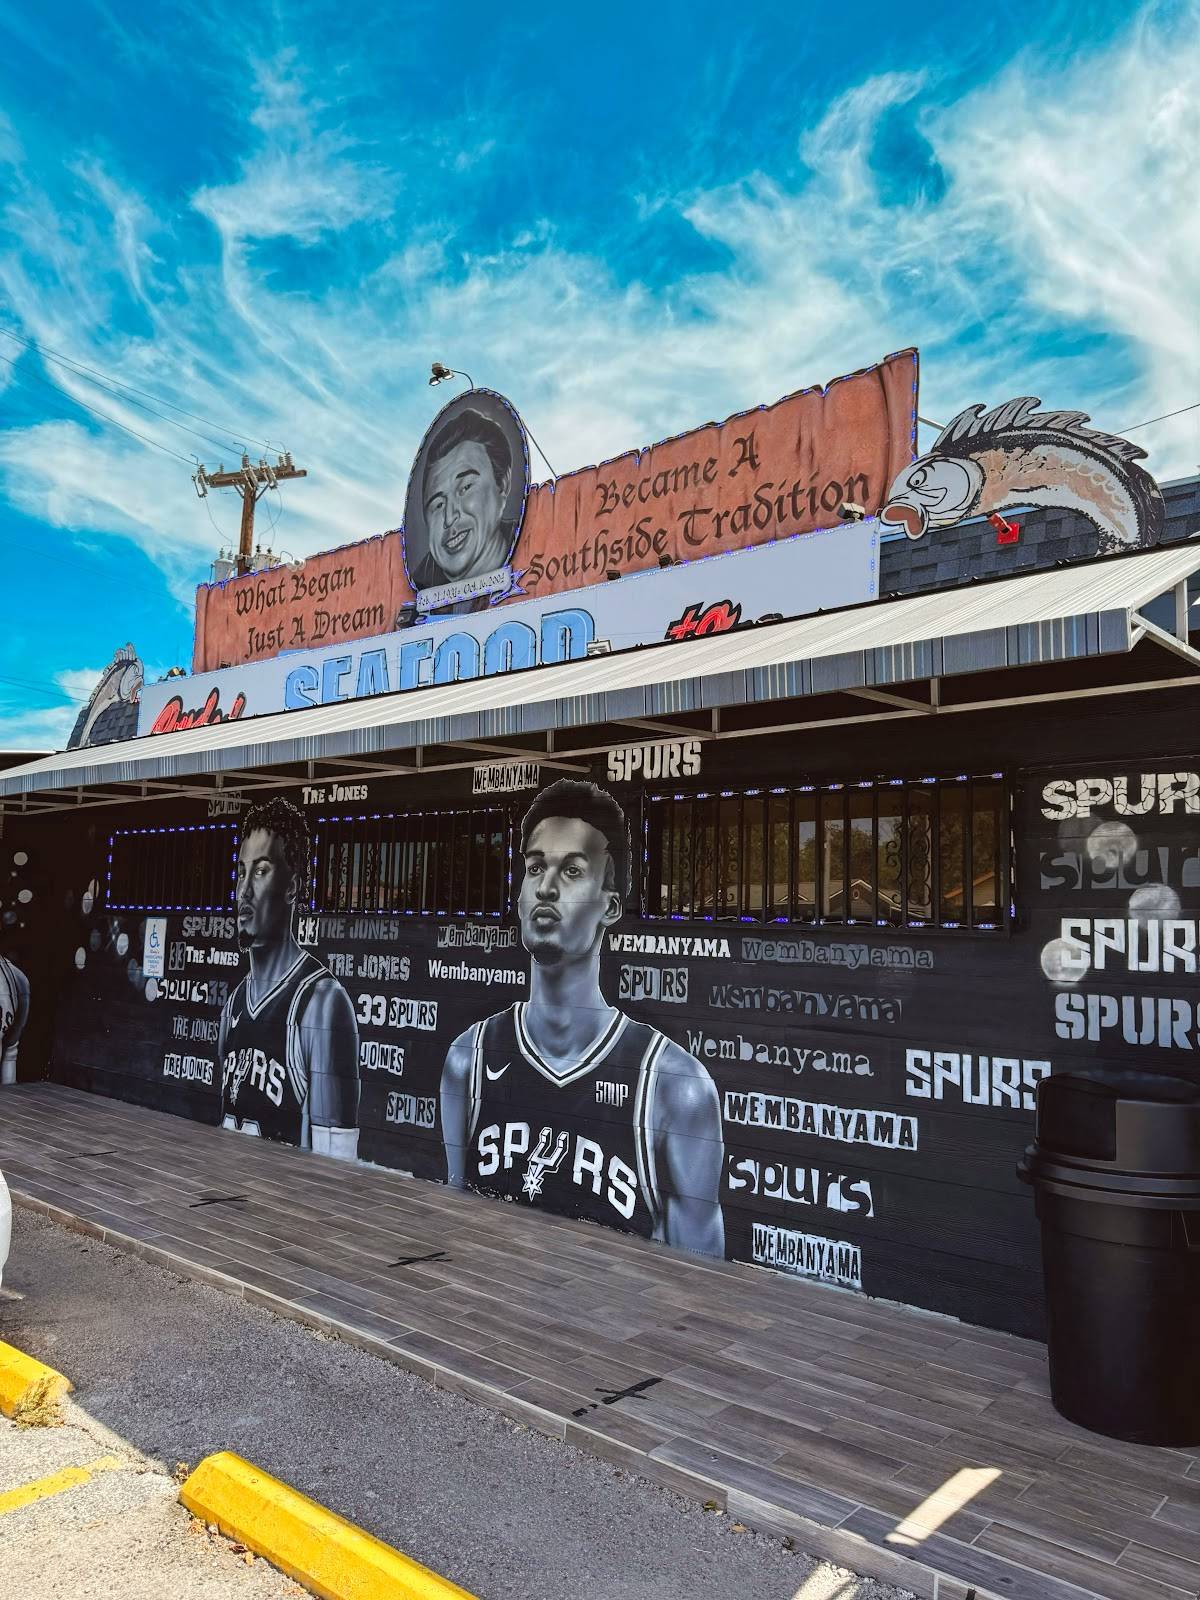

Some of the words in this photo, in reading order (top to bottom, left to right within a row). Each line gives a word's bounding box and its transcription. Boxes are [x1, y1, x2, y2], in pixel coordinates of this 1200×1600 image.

[596, 455, 718, 516] Became
[728, 431, 760, 477] A
[527, 517, 669, 587] Southside
[681, 470, 871, 547] Tradition
[234, 577, 286, 617] What
[290, 565, 356, 603] Began
[244, 620, 285, 659] Just
[289, 614, 306, 645] A
[311, 602, 385, 641] Dream
[472, 763, 541, 794] WEMBANYAMA
[608, 741, 703, 782] SPURS
[302, 787, 325, 804] TRE
[328, 784, 369, 802] JONES
[182, 916, 235, 939] SPURS
[298, 918, 319, 946] 33
[320, 917, 346, 939] TRE
[349, 918, 399, 941] JONES
[608, 933, 731, 958] WEMBANYAMA
[1061, 918, 1200, 973] SPUR
[168, 942, 186, 970] 33
[186, 946, 205, 964] TRE
[207, 947, 239, 967] JONES
[357, 955, 411, 982] JONES
[428, 959, 526, 986] Wembanyama
[618, 964, 688, 1003] SPURS
[356, 993, 387, 1026] 33
[388, 997, 438, 1031] SPURS
[1055, 993, 1200, 1049] SPUR
[190, 1019, 220, 1044] JONES
[181, 1056, 214, 1085] JONES
[360, 1041, 405, 1076] JONES
[686, 1030, 874, 1076] Wembanyama
[905, 1049, 1051, 1111] SPURS
[386, 1091, 436, 1129] SPURS
[724, 1091, 918, 1151] WEMBANYAMA
[752, 1222, 862, 1289] WEMBANYAMA
